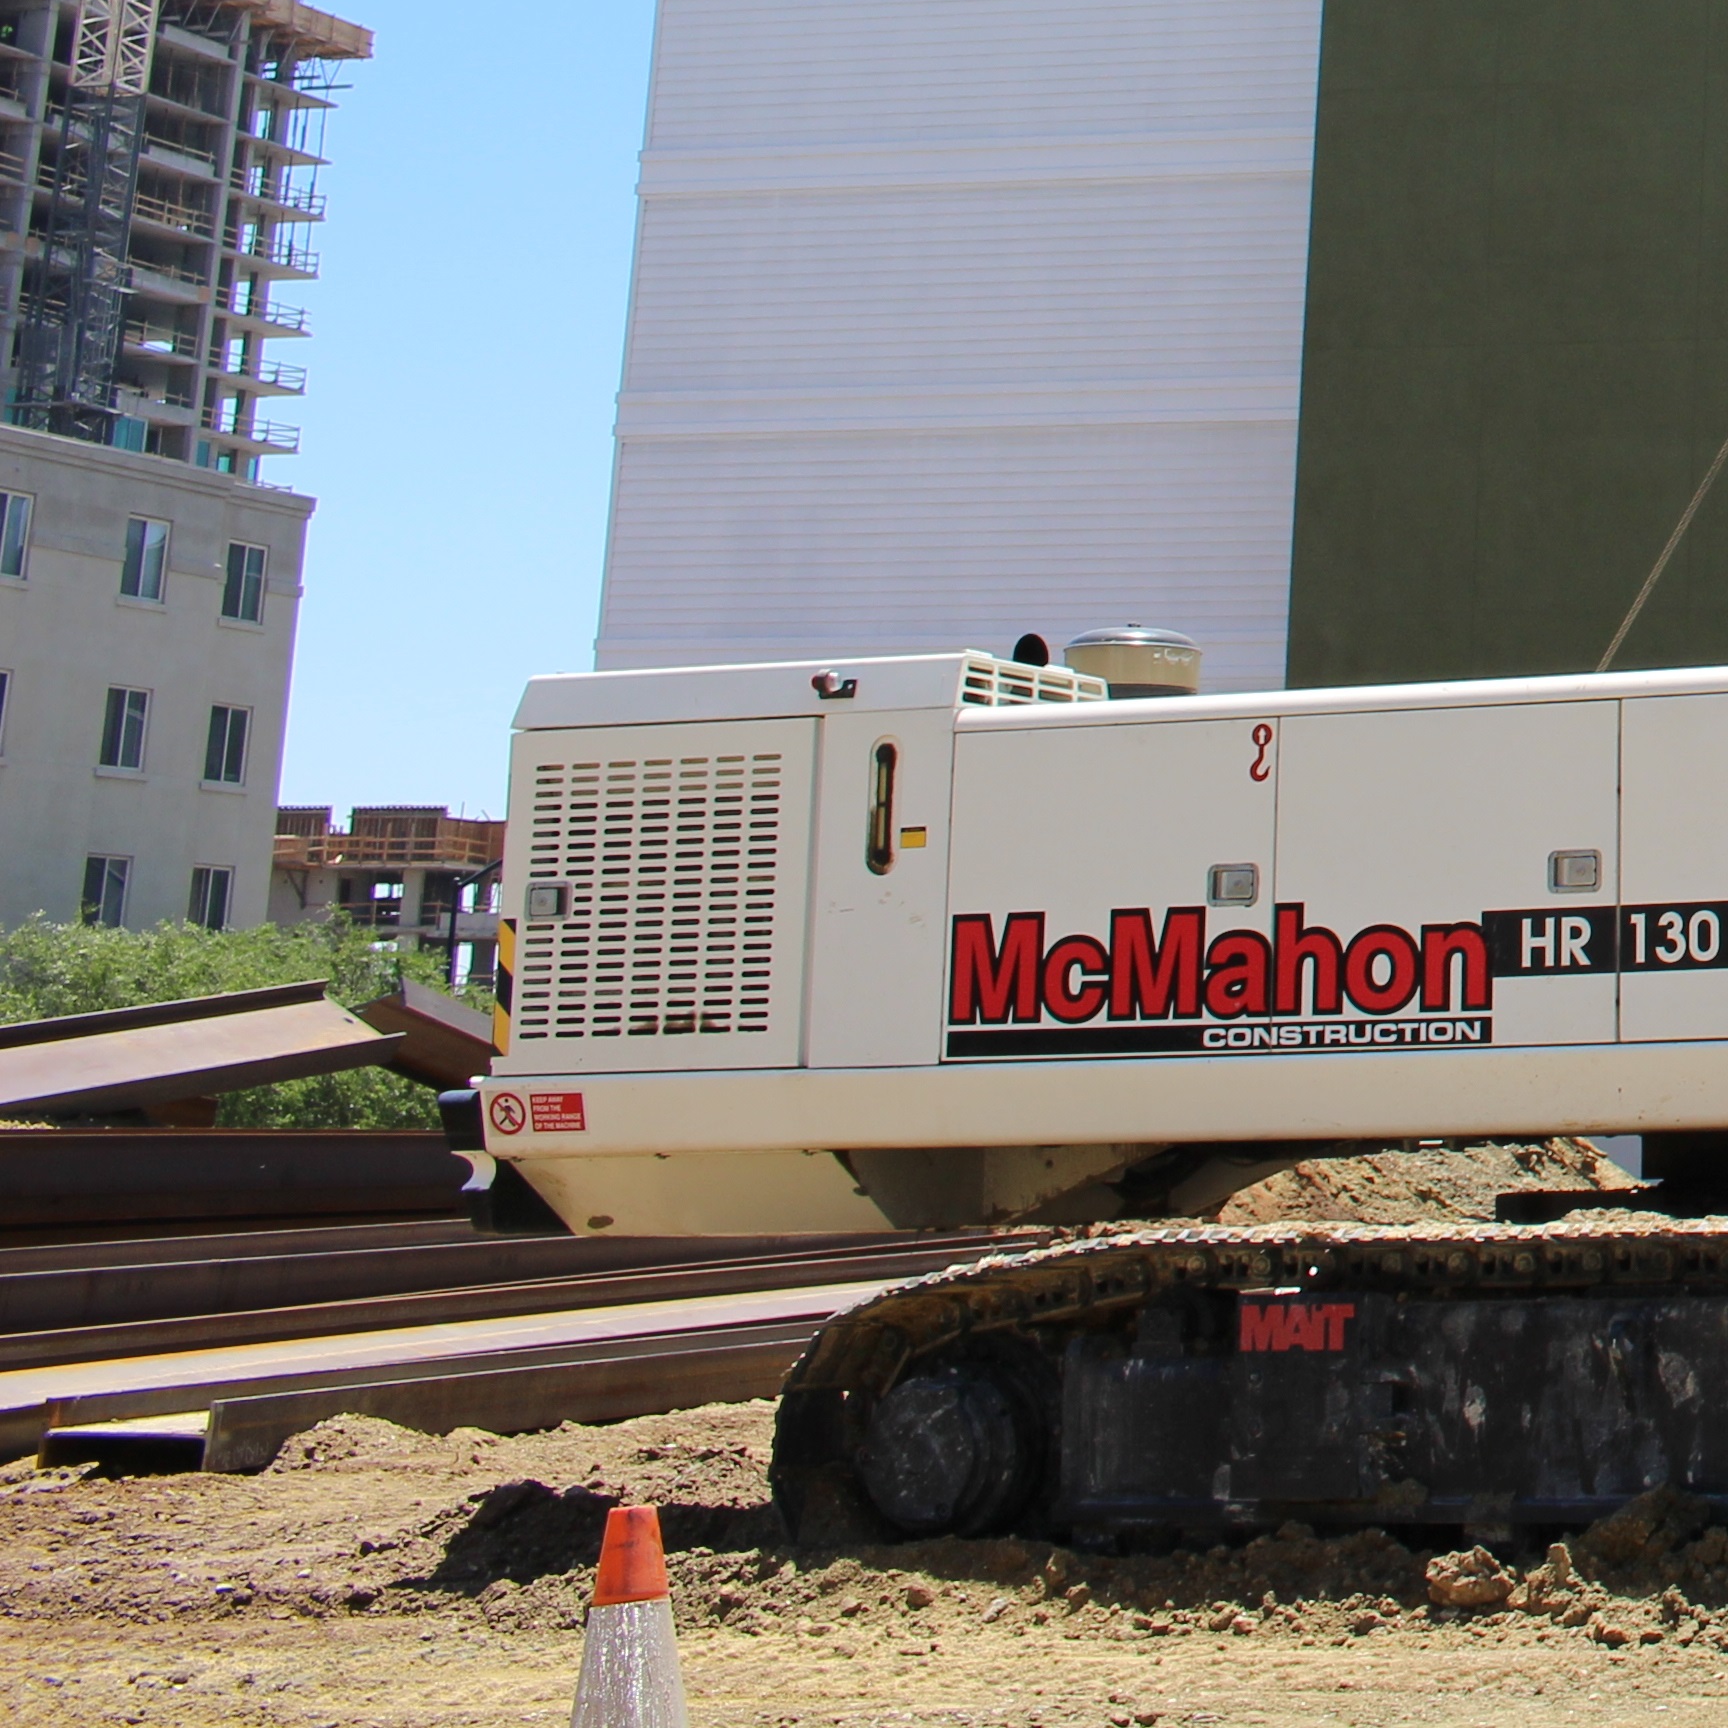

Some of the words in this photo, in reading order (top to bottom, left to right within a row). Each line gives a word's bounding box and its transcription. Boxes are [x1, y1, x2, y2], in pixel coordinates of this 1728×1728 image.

[1521, 917, 1591, 968] HR
[1630, 910, 1720, 963] 130
[948, 902, 1491, 1025] McMahon
[1202, 1020, 1482, 1048] CONSTRUCTION
[531, 1096, 548, 1104] KEEP
[532, 1104, 550, 1112] FROM
[550, 1104, 561, 1112] THE
[533, 1113, 561, 1121] WORKING
[561, 1112, 581, 1120] RANGE
[534, 1122, 543, 1130] OF
[544, 1122, 555, 1130] THE
[555, 1121, 581, 1129] MACHINE
